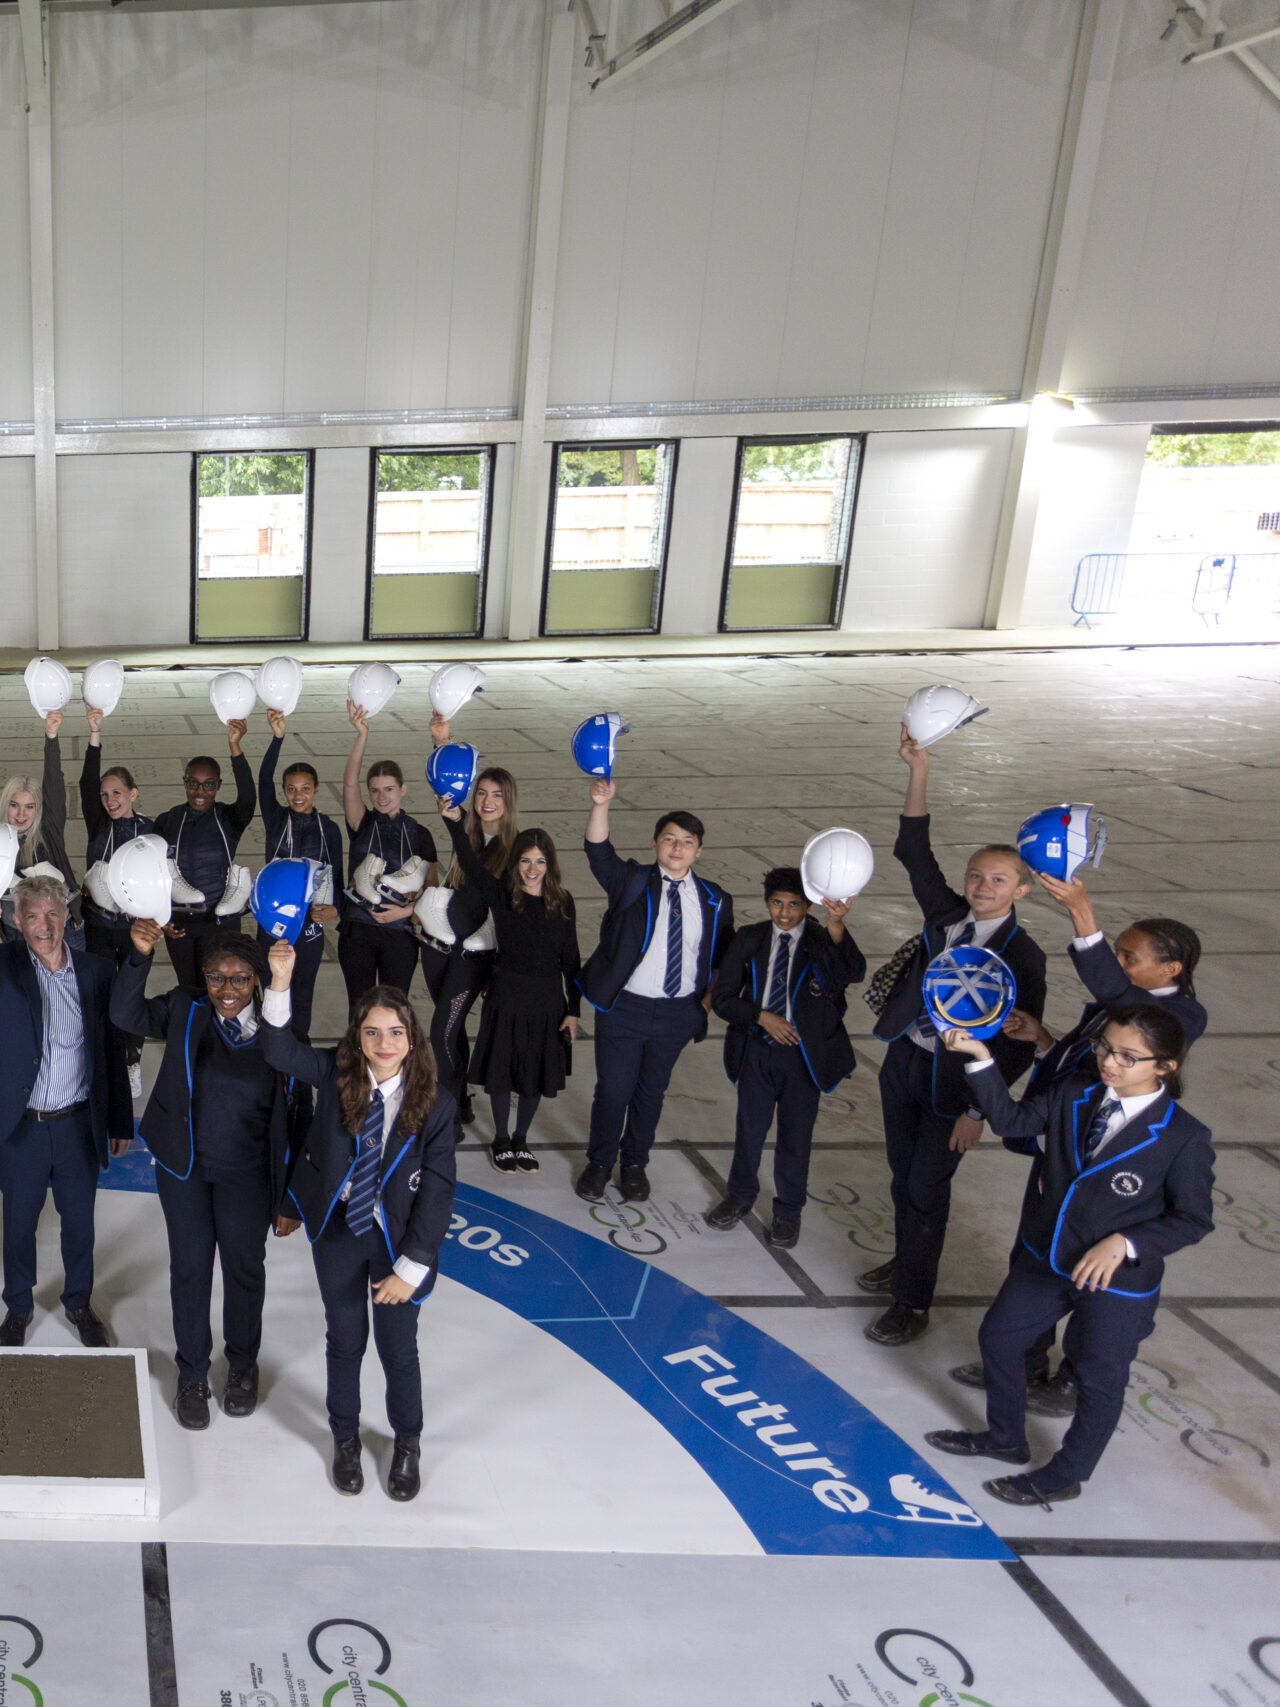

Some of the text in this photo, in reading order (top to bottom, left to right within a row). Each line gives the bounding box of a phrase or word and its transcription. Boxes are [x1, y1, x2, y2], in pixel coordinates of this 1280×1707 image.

[662, 1344, 871, 1515] Future
[297, 1678, 308, 1692] 020
[341, 1645, 368, 1707] city centra
[916, 1656, 941, 1680] city
